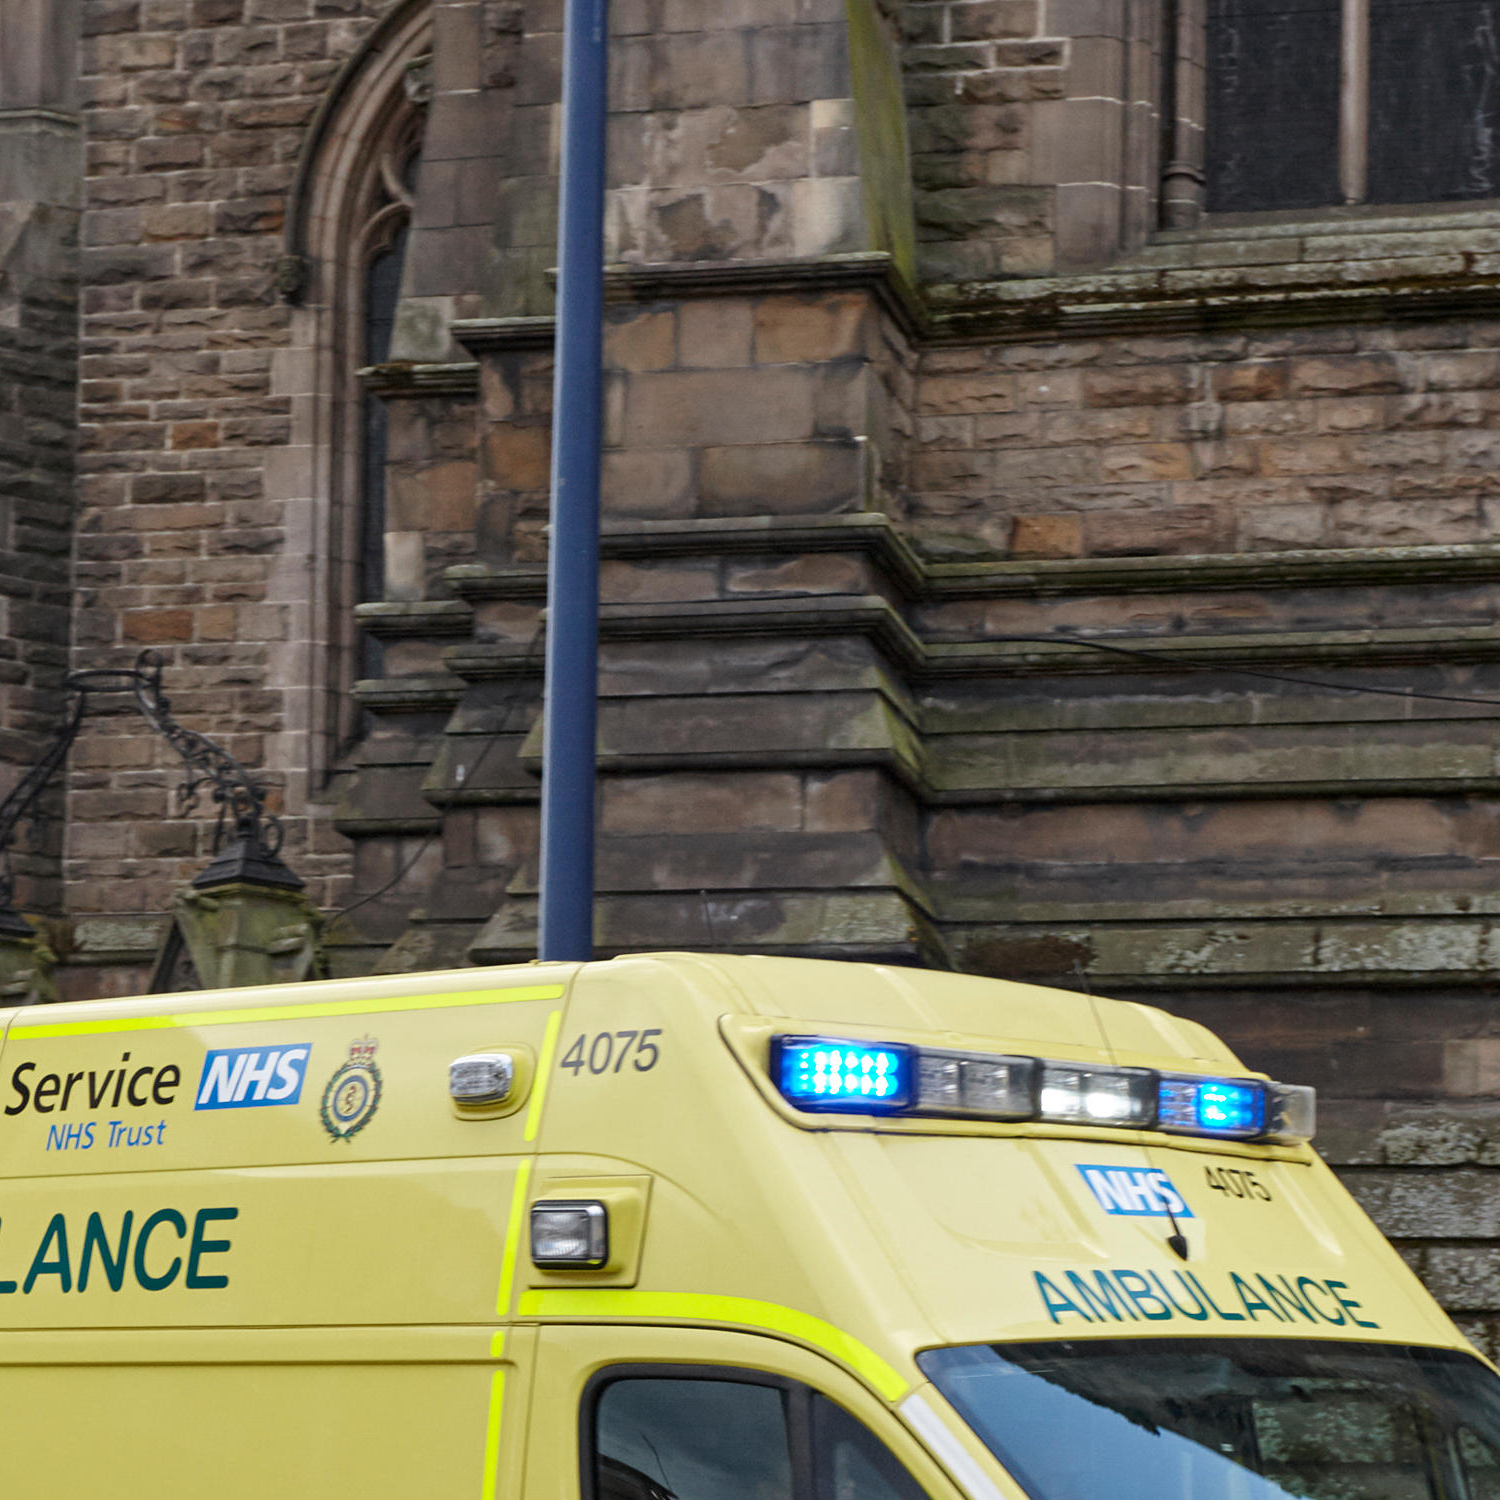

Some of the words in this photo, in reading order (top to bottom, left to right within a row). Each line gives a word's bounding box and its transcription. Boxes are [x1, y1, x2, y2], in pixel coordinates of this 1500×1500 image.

[199, 1048, 308, 1105] NHS
[560, 1028, 663, 1077] 4075
[3, 1051, 181, 1116] Service
[46, 1121, 97, 1151] NHS
[108, 1119, 167, 1148] Trust
[1085, 1169, 1185, 1213] NHS
[1205, 1166, 1272, 1202] 4075
[1033, 1269, 1380, 1328] AMBULANCE
